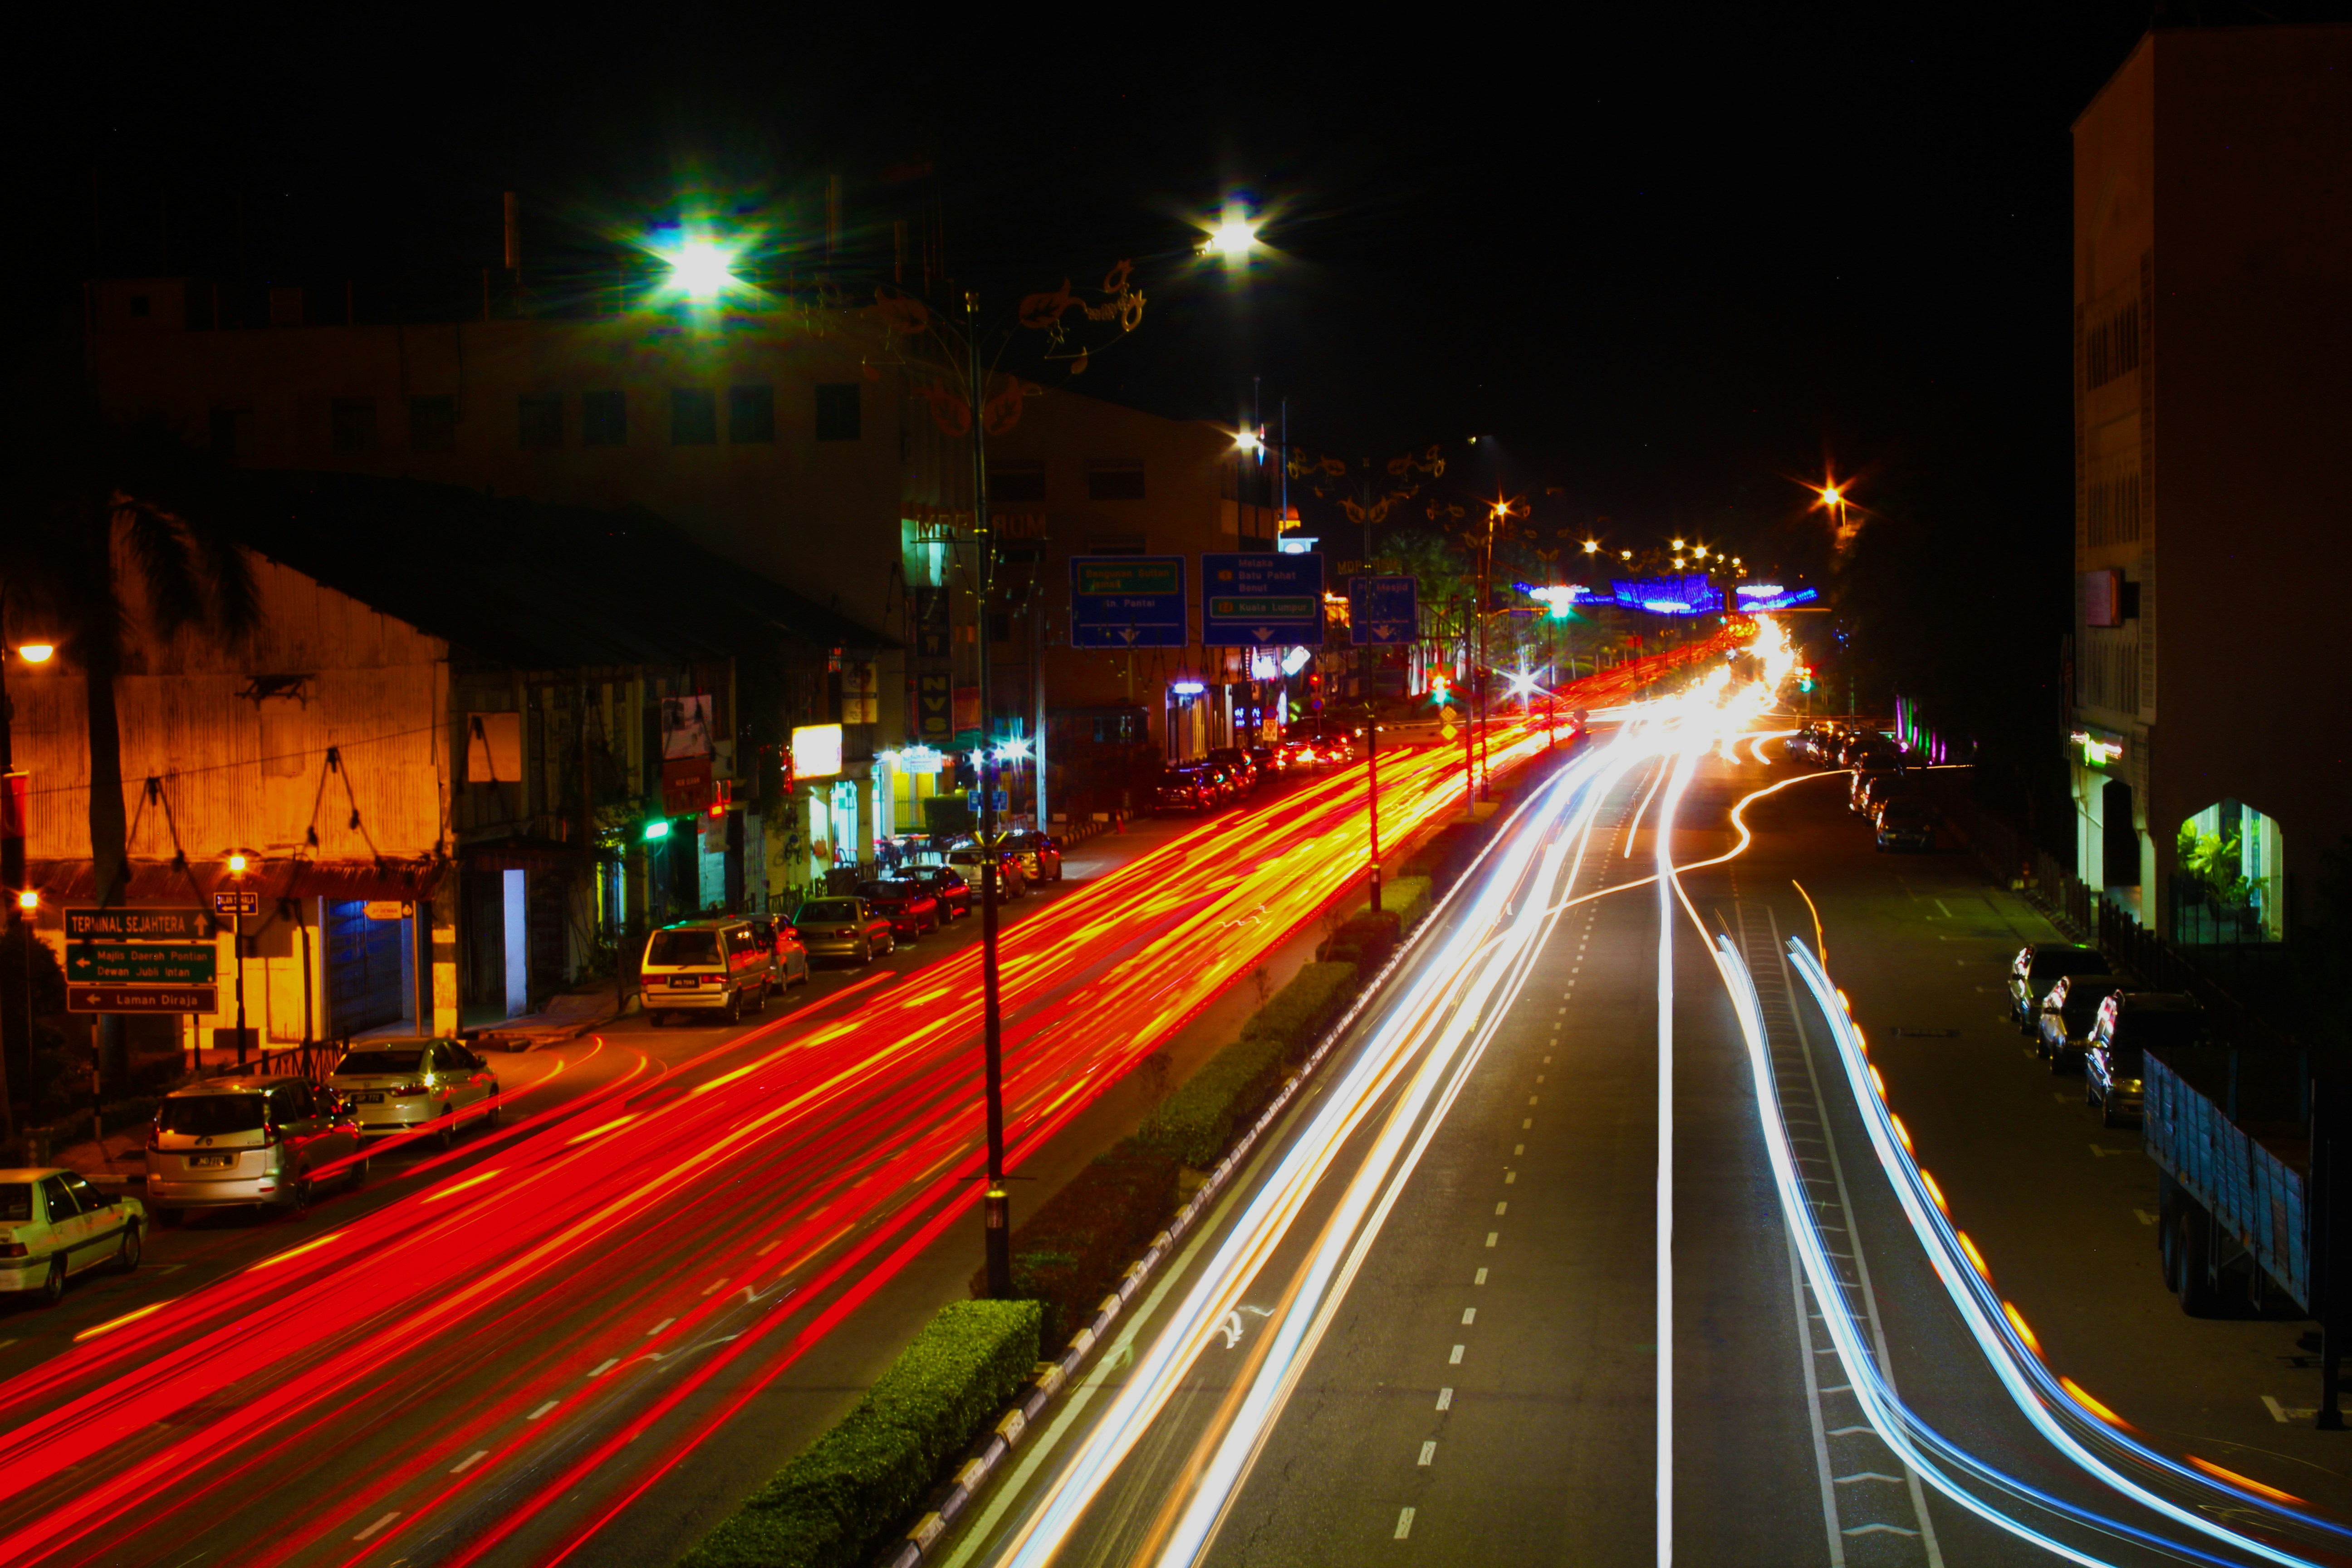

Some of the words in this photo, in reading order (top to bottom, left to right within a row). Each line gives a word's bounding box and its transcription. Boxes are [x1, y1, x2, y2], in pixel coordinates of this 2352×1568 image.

[1086, 569, 1133, 579] Bangunan
[1268, 571, 1296, 579] Pahat
[1377, 583, 1408, 593] Mesjid
[1124, 599, 1155, 607] Pantai
[1240, 603, 1266, 611] Kuala
[1273, 603, 1307, 613] Lumpur
[923, 676, 946, 732] NVS
[72, 916, 122, 932] TERMINAL
[126, 916, 185, 932] SEJAHTERA
[98, 951, 125, 962] Majlis
[131, 951, 165, 960] Daerah
[171, 951, 207, 961] Pontian
[98, 966, 129, 976] Dewan
[137, 967, 158, 977] Jubli
[165, 967, 190, 977] Intan
[117, 995, 155, 1005] Laman
[162, 995, 197, 1007] Diraja
